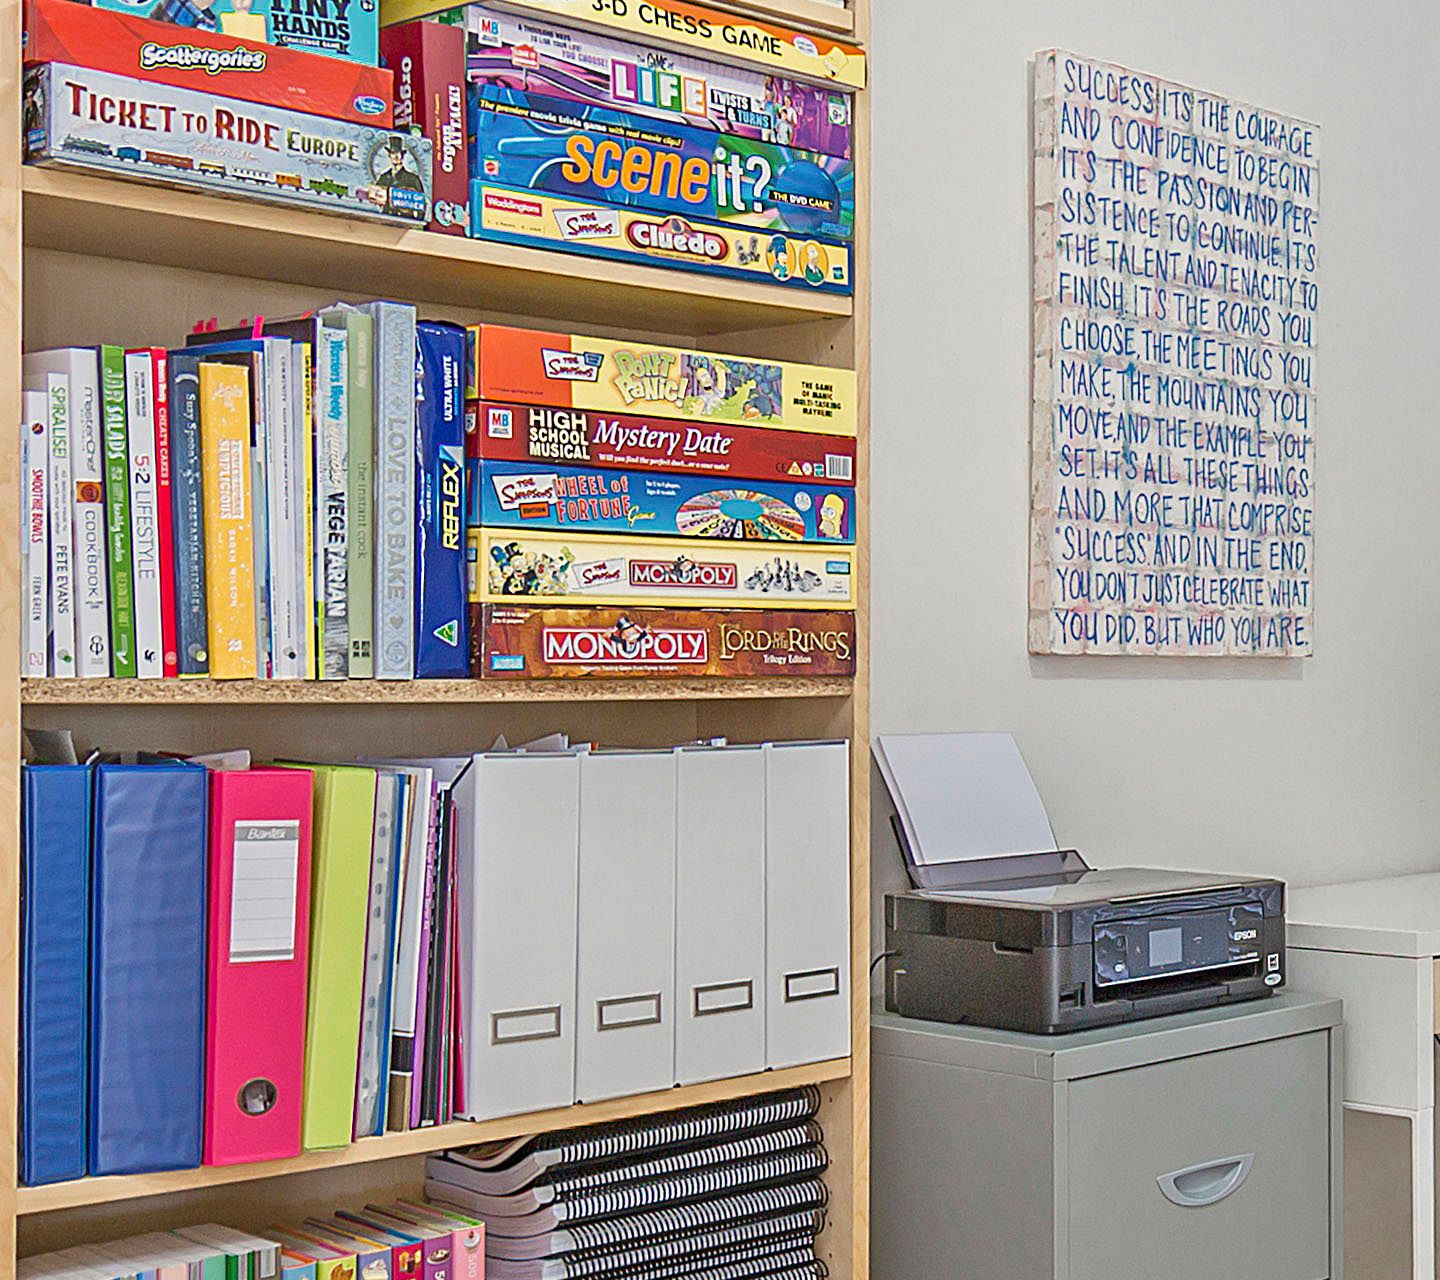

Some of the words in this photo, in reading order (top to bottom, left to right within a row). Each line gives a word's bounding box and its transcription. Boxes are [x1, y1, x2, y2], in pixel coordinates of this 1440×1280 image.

[272, 13, 351, 42] HANDS
[639, 3, 713, 40] CHESS
[722, 26, 782, 57] GAME
[141, 42, 266, 75] Scattergories
[65, 81, 178, 134] TICKET
[182, 112, 208, 133] TO
[214, 109, 282, 152] RIDE
[285, 128, 360, 163] EUROPE
[1199, 99, 1229, 132] THE
[1235, 110, 1313, 158] COURAGE
[562, 133, 710, 204] scene
[714, 146, 772, 213] it?
[1061, 102, 1101, 142] AND
[1111, 116, 1228, 175] CONFIDENCE
[1235, 150, 1255, 182] TO
[1258, 156, 1311, 197] BEGIN
[1062, 147, 1096, 183] IT'S
[1110, 159, 1147, 195] THE
[1159, 171, 1240, 217] PASSION
[1244, 192, 1278, 226] AND
[1282, 200, 1318, 237] PER-
[631, 221, 722, 258] Cluedo
[1061, 187, 1159, 238] SISTENCE
[1165, 213, 1189, 242] TO
[1199, 222, 1283, 268] CONTINUE.
[1286, 238, 1315, 272] IT'S
[1061, 233, 1099, 267] THE
[1107, 240, 1181, 282] TALENT
[1185, 254, 1216, 288] AND
[1221, 264, 1296, 308] TENACITY
[1300, 281, 1318, 312] TO
[1059, 272, 1128, 314] FINISH.
[1134, 286, 1167, 320] IT'S
[1174, 292, 1208, 326] THE
[1218, 300, 1270, 337] ROADS
[1278, 312, 1311, 347] YOU
[1061, 317, 1140, 359] CHOOSE,
[1142, 330, 1171, 363] THE
[1177, 335, 1272, 382] MEETINGS
[1279, 351, 1311, 388] YOU
[529, 408, 587, 431] HIGH
[1117, 370, 1151, 404] THE
[1158, 377, 1260, 418] MOUNTAINS
[1269, 389, 1307, 428] YOU
[387, 417, 407, 484] LOVE
[529, 427, 589, 445] SCHOOL
[529, 442, 590, 460] MUSICAL
[593, 419, 680, 456] Mystery
[683, 427, 732, 456] Date
[1117, 416, 1150, 444] AND
[1155, 418, 1187, 448] THE
[1194, 422, 1266, 457] EXAMPLE
[1274, 431, 1310, 463] YOU
[1059, 444, 1100, 479] SET.
[1104, 449, 1137, 479] IT'S
[1144, 452, 1177, 485] ALL
[1184, 457, 1238, 493] THESE
[1243, 464, 1309, 498] THINGS
[388, 492, 407, 526] TO
[442, 463, 460, 550] REFLEX
[1058, 486, 1105, 522] AND
[1114, 490, 1173, 528] MORE
[1179, 496, 1223, 530] THAT
[1228, 501, 1311, 537] COMPRISE
[387, 533, 407, 600] BAKE
[1154, 535, 1190, 566] AND
[1196, 537, 1217, 568] IN
[1224, 538, 1261, 570] THE
[1056, 568, 1091, 602] YOU
[1096, 572, 1139, 602] DON'T
[1143, 573, 1181, 604] JUST
[1184, 576, 1264, 606] CELEBRATE
[1267, 579, 1309, 608] WHAT
[547, 633, 704, 660] MONOPOLY
[1055, 611, 1098, 645] YOU
[1145, 616, 1181, 645] BUT
[1187, 615, 1225, 642] WHO
[1231, 616, 1259, 649] YOU
[1266, 616, 1309, 648] ARE.
[1234, 930, 1257, 941] EPSON
